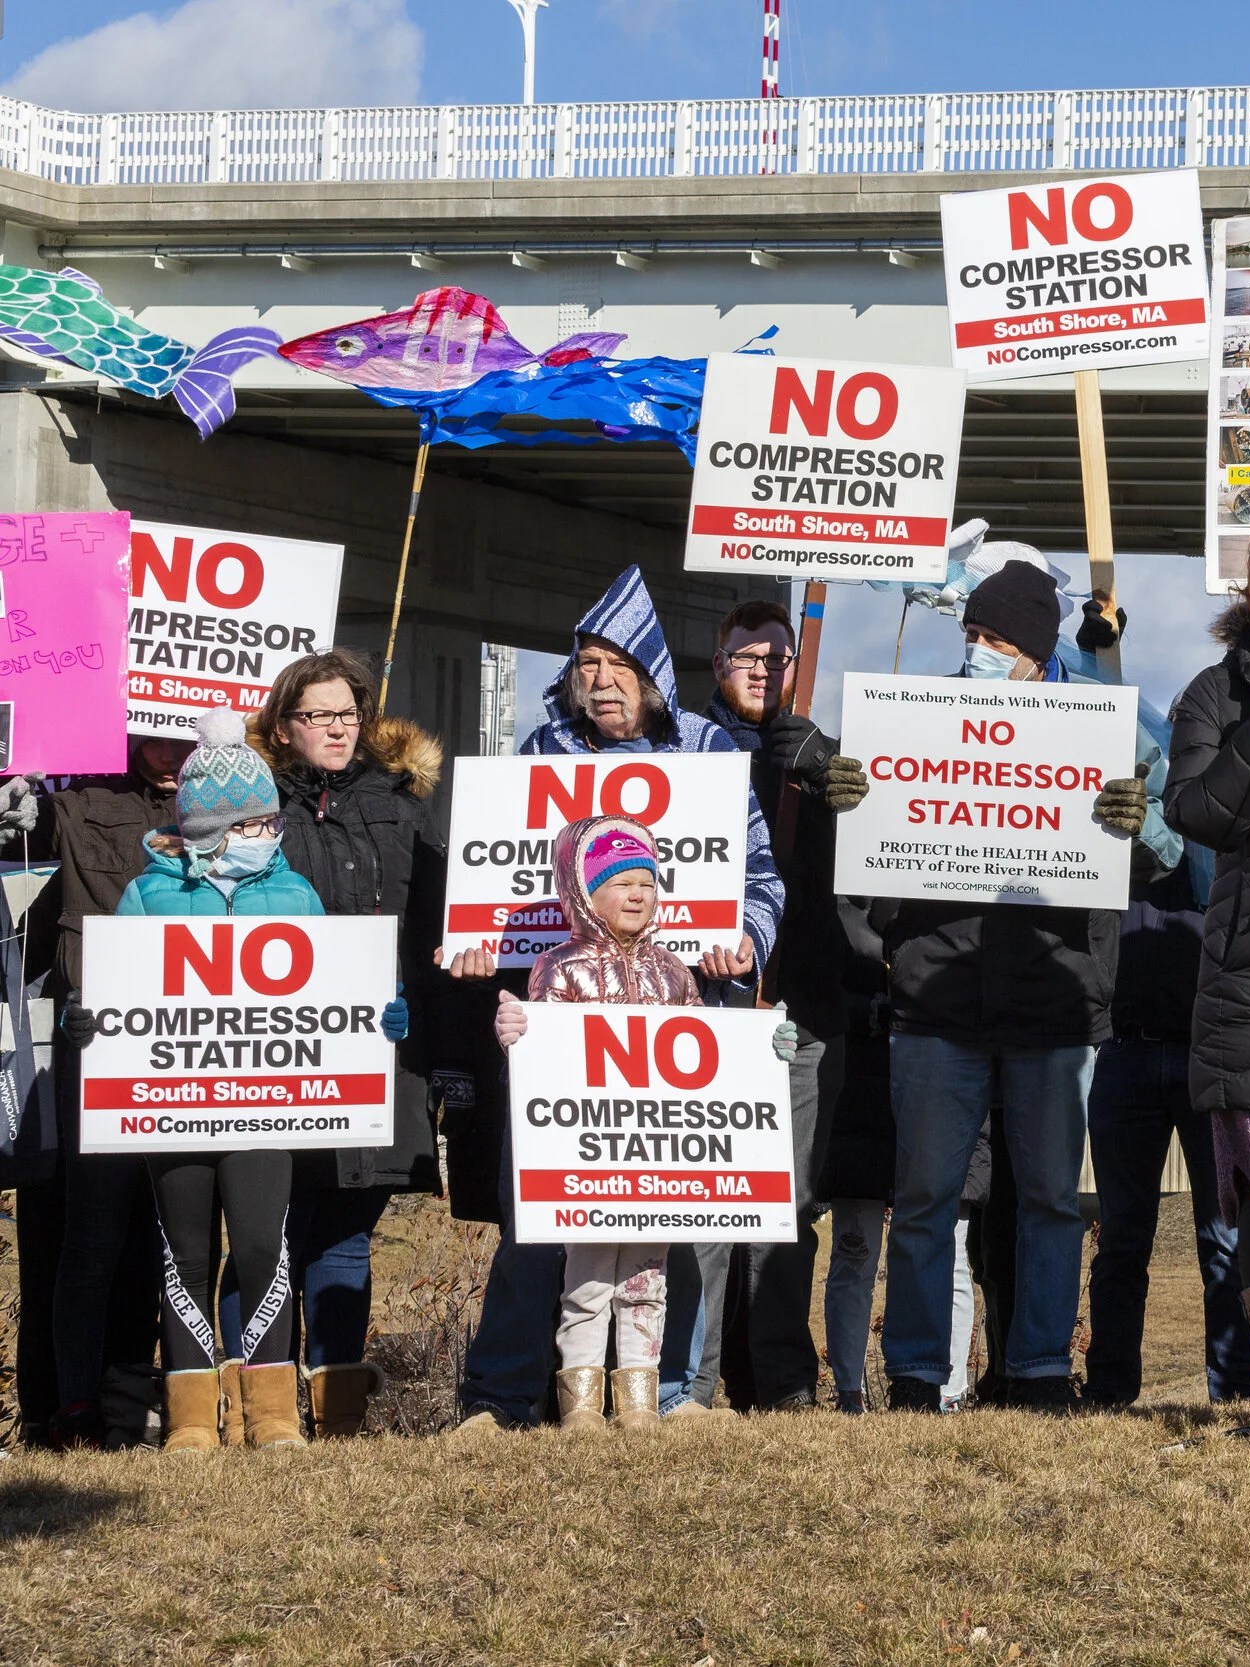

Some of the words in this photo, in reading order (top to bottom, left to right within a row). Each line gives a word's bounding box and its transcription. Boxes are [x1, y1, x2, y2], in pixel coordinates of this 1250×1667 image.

[1008, 182, 1133, 250] NO
[960, 244, 1192, 288] COMPRESSOR
[1006, 274, 1148, 310] STATION
[994, 317, 1054, 338] South
[1059, 311, 1126, 330] Shore,
[1132, 306, 1168, 324] MA
[987, 334, 1177, 365] NOCompressor.com
[769, 366, 899, 441] NO
[709, 441, 945, 480] COMPRESSOR
[751, 475, 897, 508] STATION
[733, 512, 796, 533] South
[801, 517, 869, 540] Shore,
[875, 520, 909, 539] MA
[130, 531, 264, 609] NO
[720, 543, 914, 568] NOCompressor.com
[128, 607, 316, 653] MPRESSOR
[34, 643, 104, 674] YOU
[129, 637, 263, 678] TATION
[159, 679, 232, 706] Shore,
[864, 689, 897, 701] West
[901, 691, 957, 706] Roxbury
[960, 695, 1005, 706] Stands
[1008, 697, 1040, 708] With
[1044, 699, 1116, 712] Weymouth
[961, 719, 1015, 746] NO
[870, 755, 1103, 792] COMPRESSOR
[526, 762, 671, 830] NO
[908, 798, 1061, 831] STATION
[462, 837, 730, 866] COMSOR
[880, 841, 952, 855] PROTECT
[955, 845, 978, 857] the
[982, 847, 1048, 861] HEALTH
[1051, 851, 1087, 863] AND
[865, 857, 924, 870] SAFETY
[928, 860, 945, 871] of
[947, 861, 980, 874] Fore
[984, 863, 1024, 876] River
[1028, 866, 1099, 880] Residents
[940, 882, 1039, 894] NOCOMPRESSOR.COM
[493, 907, 562, 926] South
[658, 903, 693, 923] MA
[162, 922, 314, 996] NO
[96, 1005, 377, 1037] COMPRESSOR
[149, 1039, 322, 1069] STATION
[583, 1014, 719, 1090] NO
[132, 1082, 206, 1103] South
[213, 1081, 294, 1104] Shore,
[300, 1079, 341, 1099] MA
[120, 1115, 349, 1137] NOCompressor.com
[526, 1098, 779, 1131] COMPRESSOR
[578, 1132, 733, 1163] STATION
[564, 1174, 632, 1195] South
[638, 1175, 710, 1199] Shore,
[716, 1176, 752, 1196] MA
[555, 1209, 761, 1231] NOCompressor.com
[188, 1318, 214, 1353] JUST
